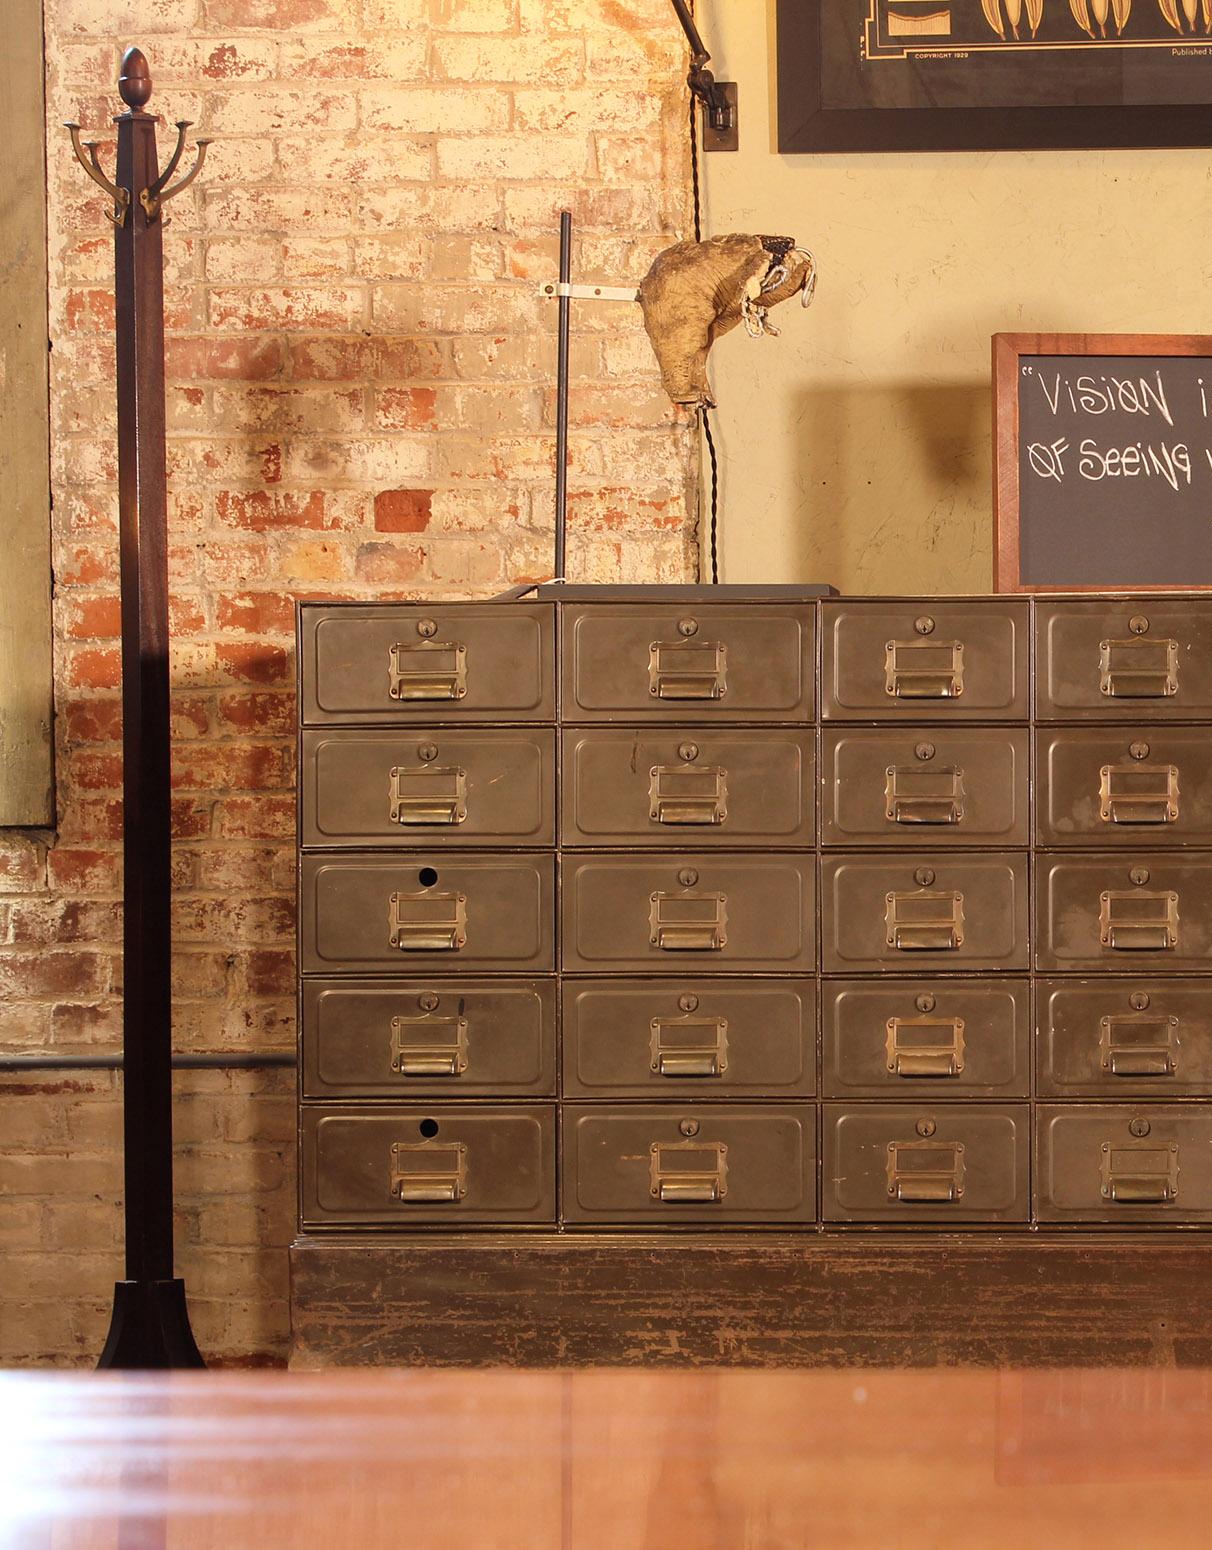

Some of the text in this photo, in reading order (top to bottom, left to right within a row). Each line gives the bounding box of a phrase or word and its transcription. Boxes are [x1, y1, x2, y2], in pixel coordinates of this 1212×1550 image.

[914, 52, 952, 60] COPYRIGHT
[1171, 47, 1207, 56] Published
[1026, 436, 1070, 483] OF
